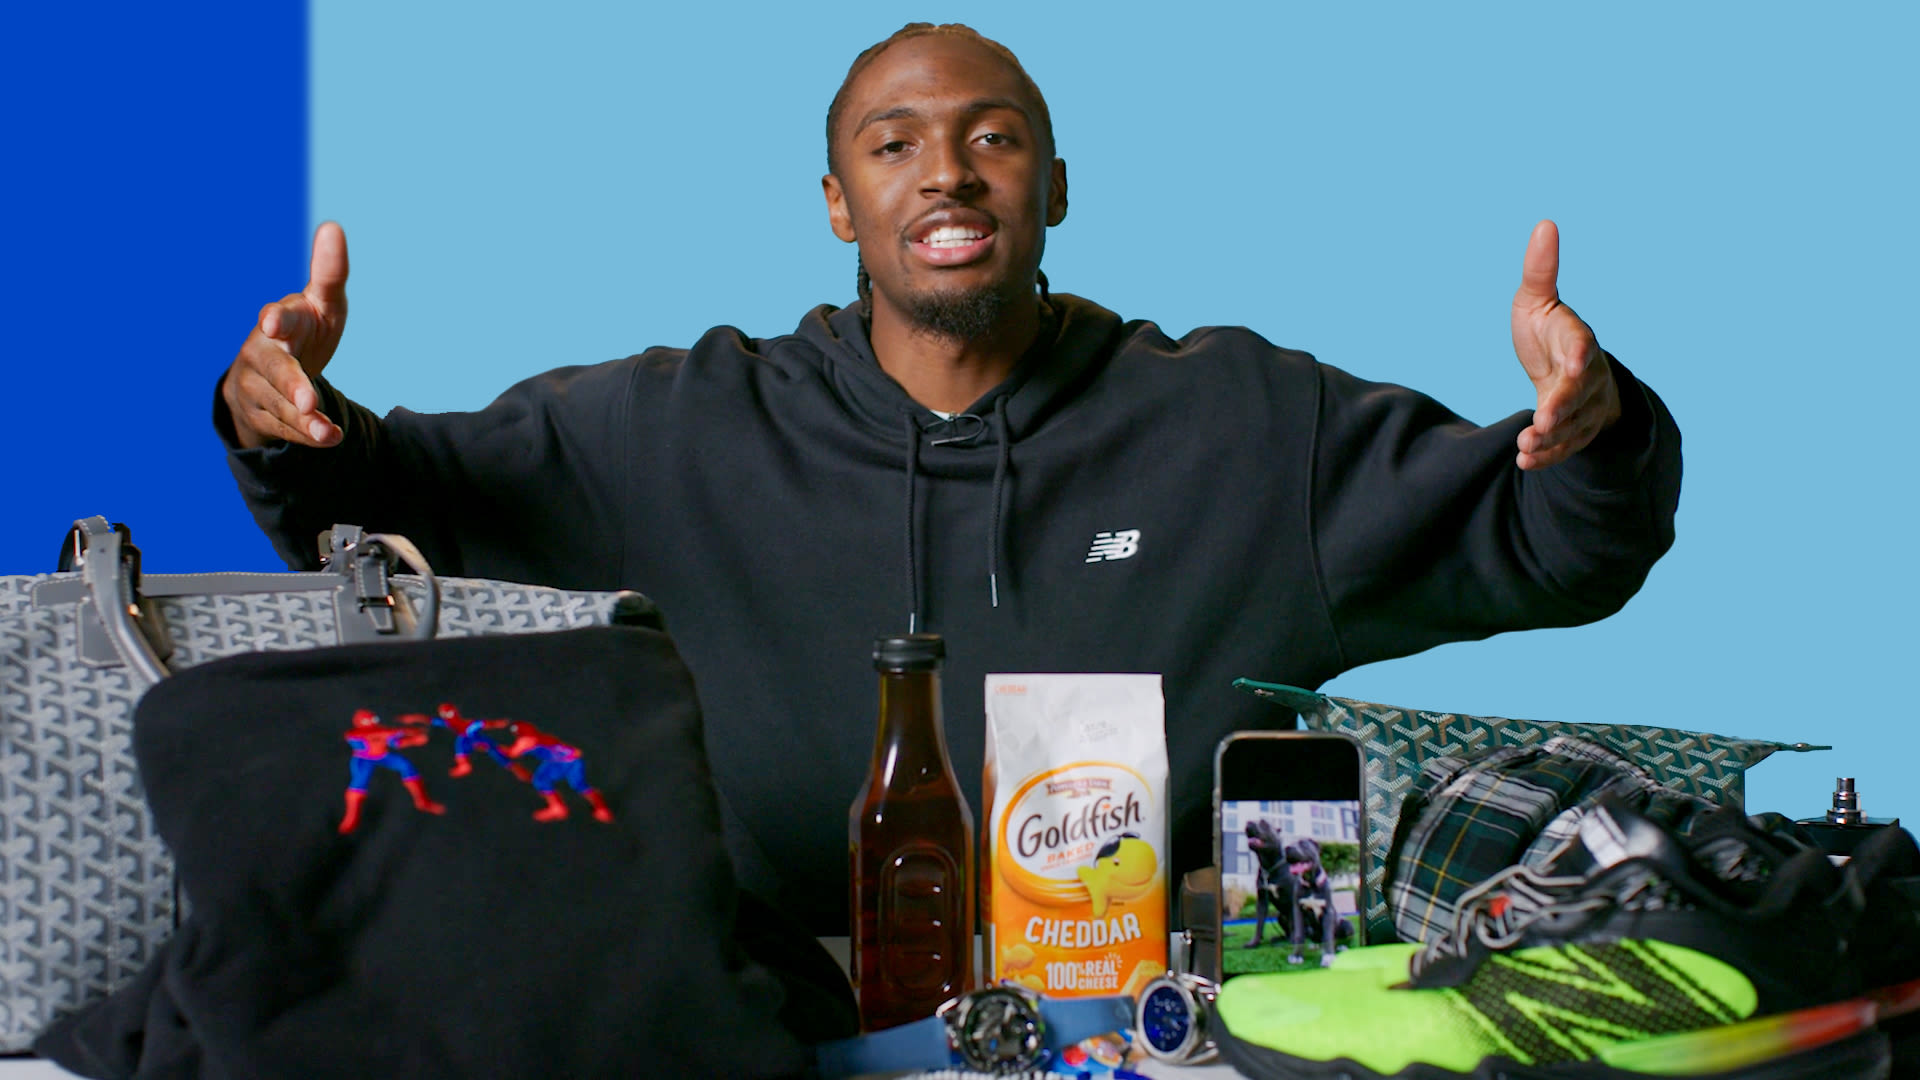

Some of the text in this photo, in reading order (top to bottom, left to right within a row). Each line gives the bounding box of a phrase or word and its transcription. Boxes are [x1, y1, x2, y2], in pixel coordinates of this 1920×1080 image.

[1017, 791, 1140, 858] Goldfish
[1025, 912, 1142, 948] CHEDDAR
[1085, 960, 1119, 976] REAL
[1078, 976, 1119, 990] CHEESE
